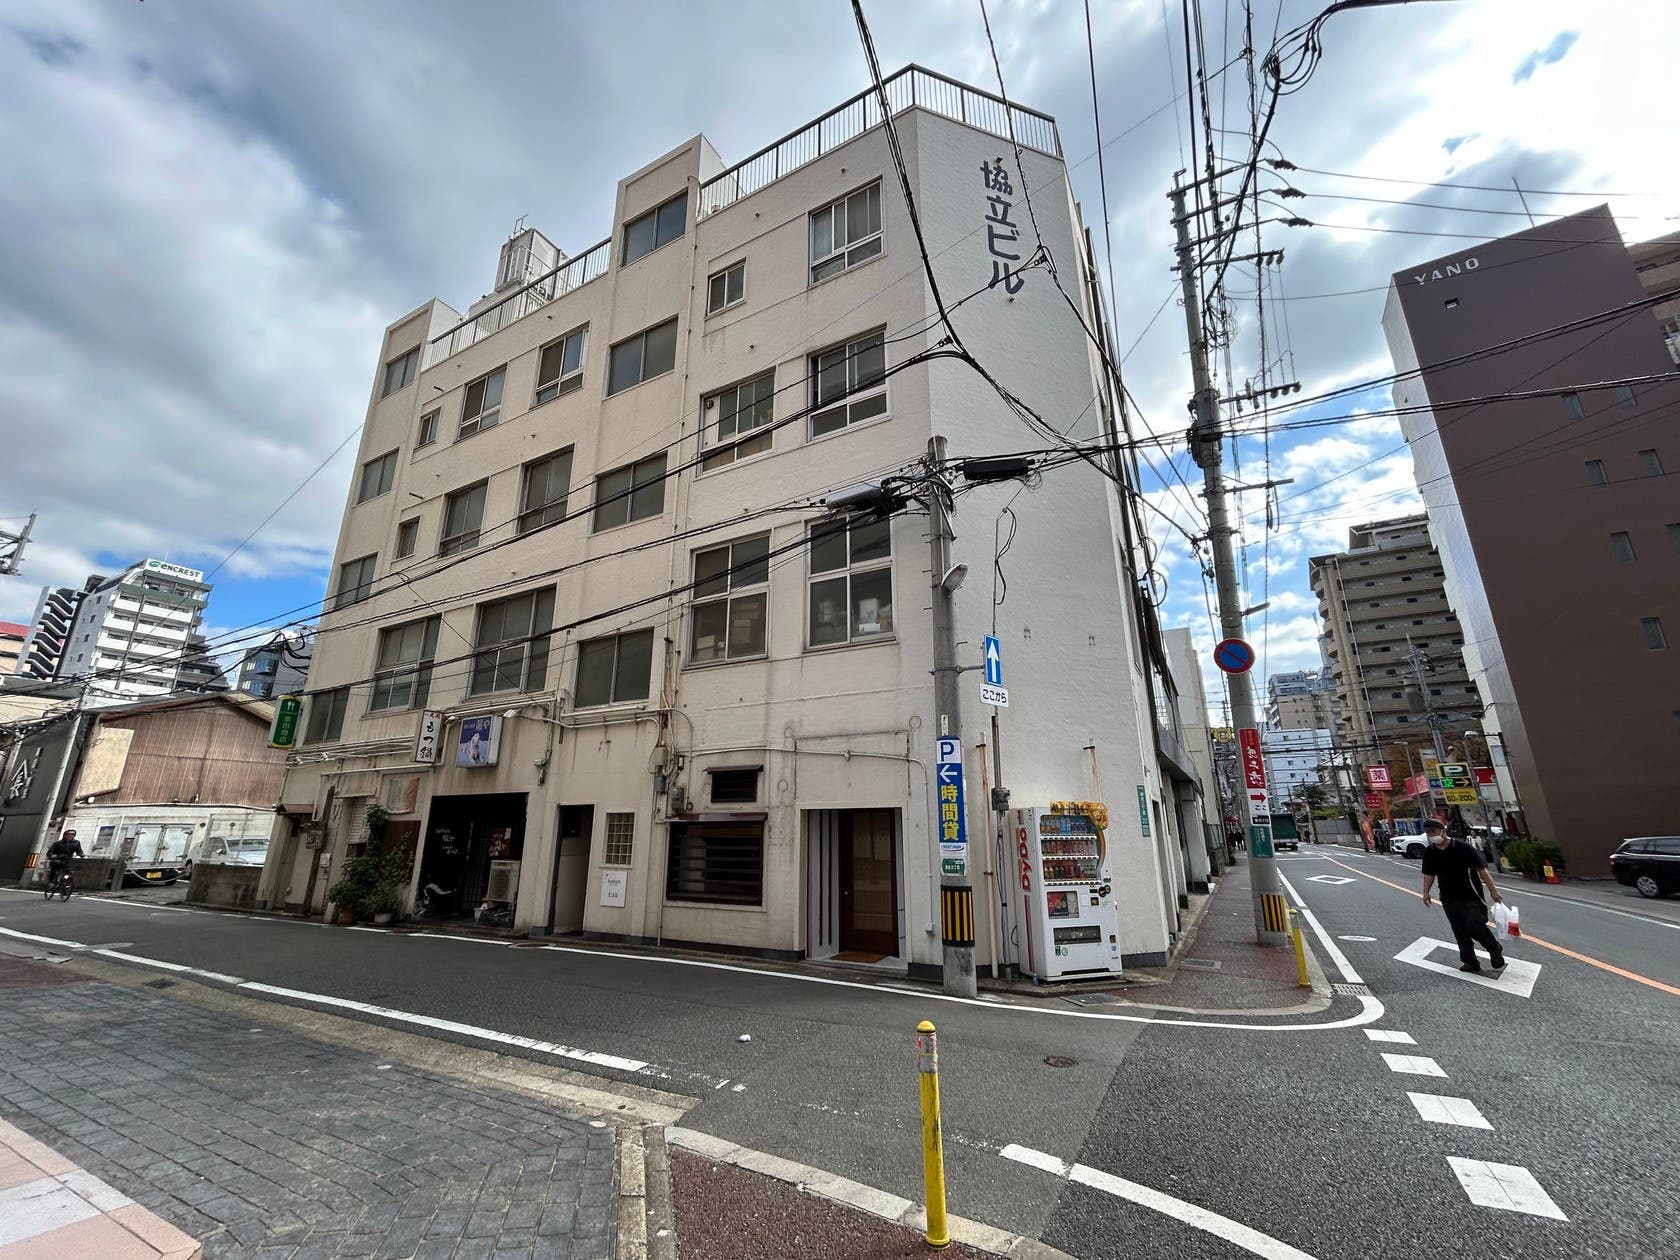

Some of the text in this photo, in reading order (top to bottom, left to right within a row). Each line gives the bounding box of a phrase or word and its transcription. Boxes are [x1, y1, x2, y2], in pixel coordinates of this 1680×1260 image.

[980, 159, 1024, 294] 協立ビル
[1414, 257, 1480, 285] YANO
[983, 689, 1007, 703] ここから
[420, 721, 434, 760] もつ鍋
[941, 742, 954, 762] P
[1443, 766, 1463, 776] P
[941, 784, 959, 840] 時間貸
